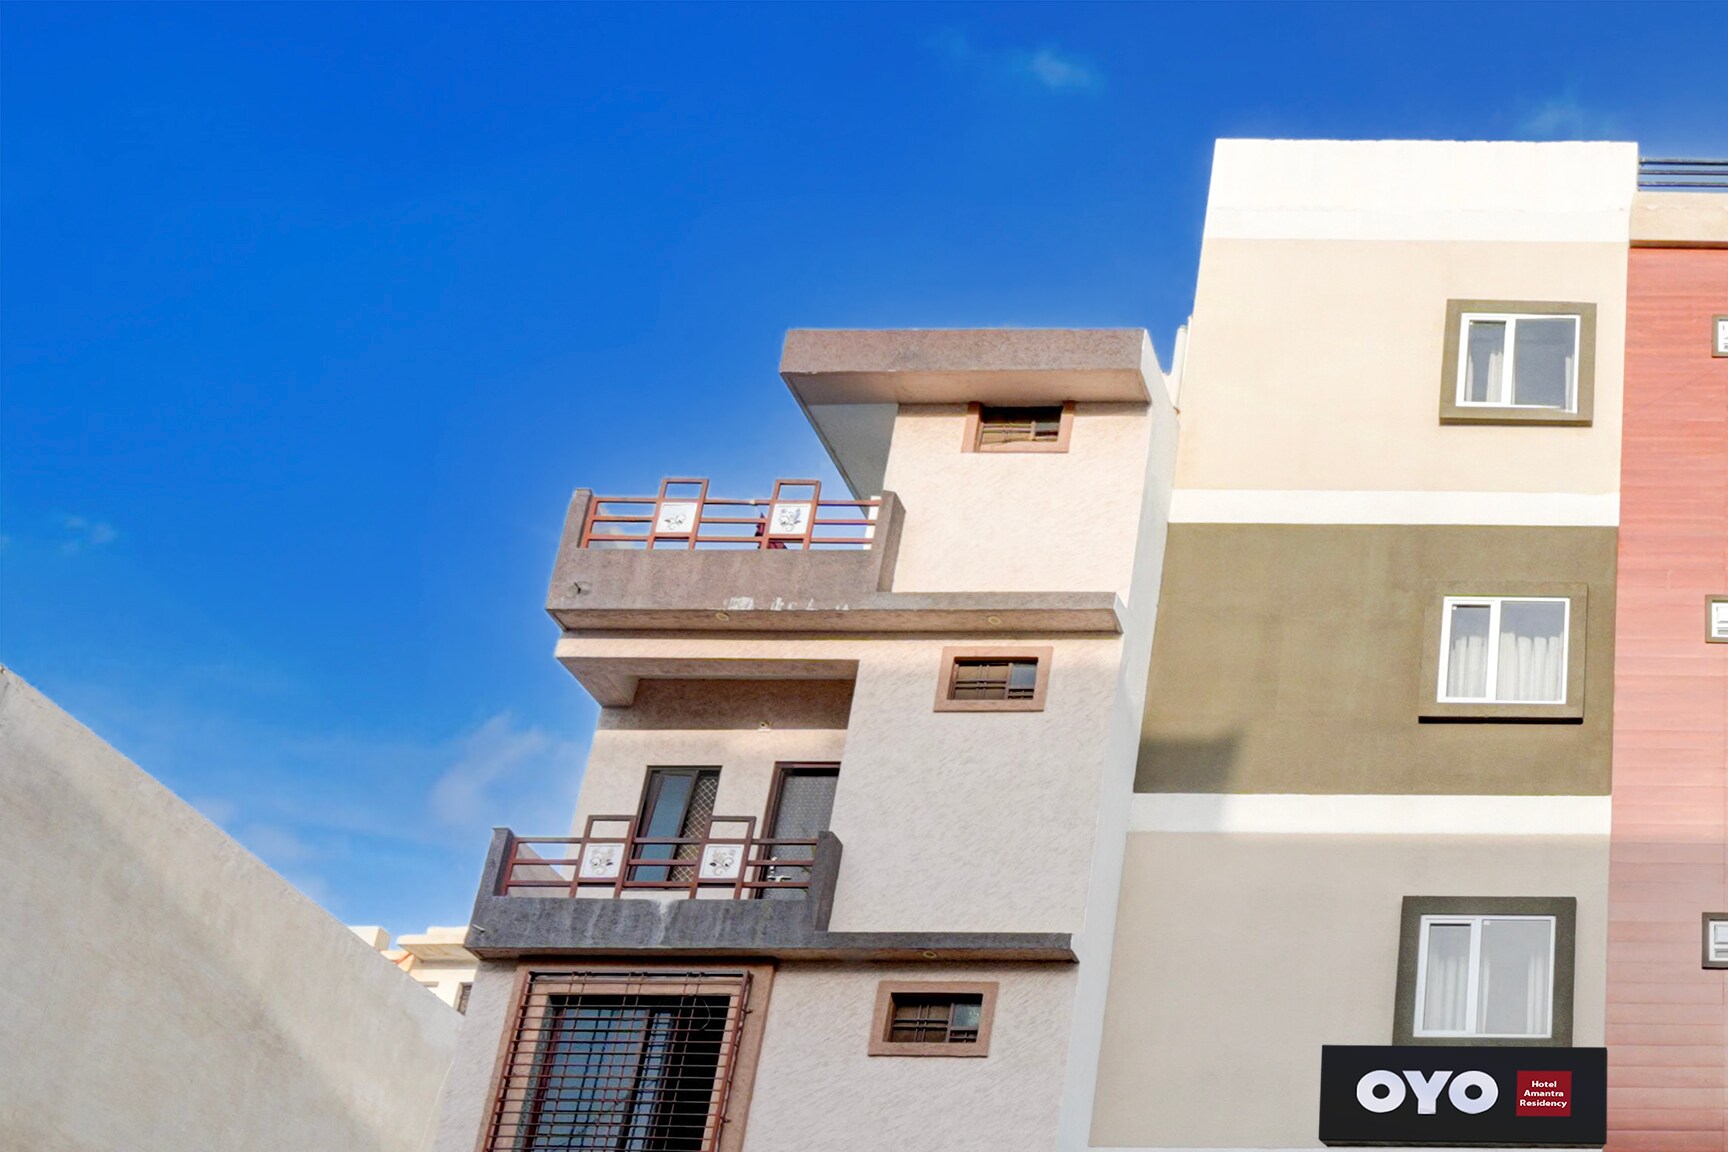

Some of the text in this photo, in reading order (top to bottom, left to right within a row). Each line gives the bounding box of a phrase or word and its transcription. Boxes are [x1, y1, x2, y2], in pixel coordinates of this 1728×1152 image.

[1531, 1080, 1557, 1088] Hotel
[1356, 1070, 1499, 1114] OYO
[1523, 1089, 1564, 1097] Amantra
[1519, 1099, 1567, 1108] Residency
